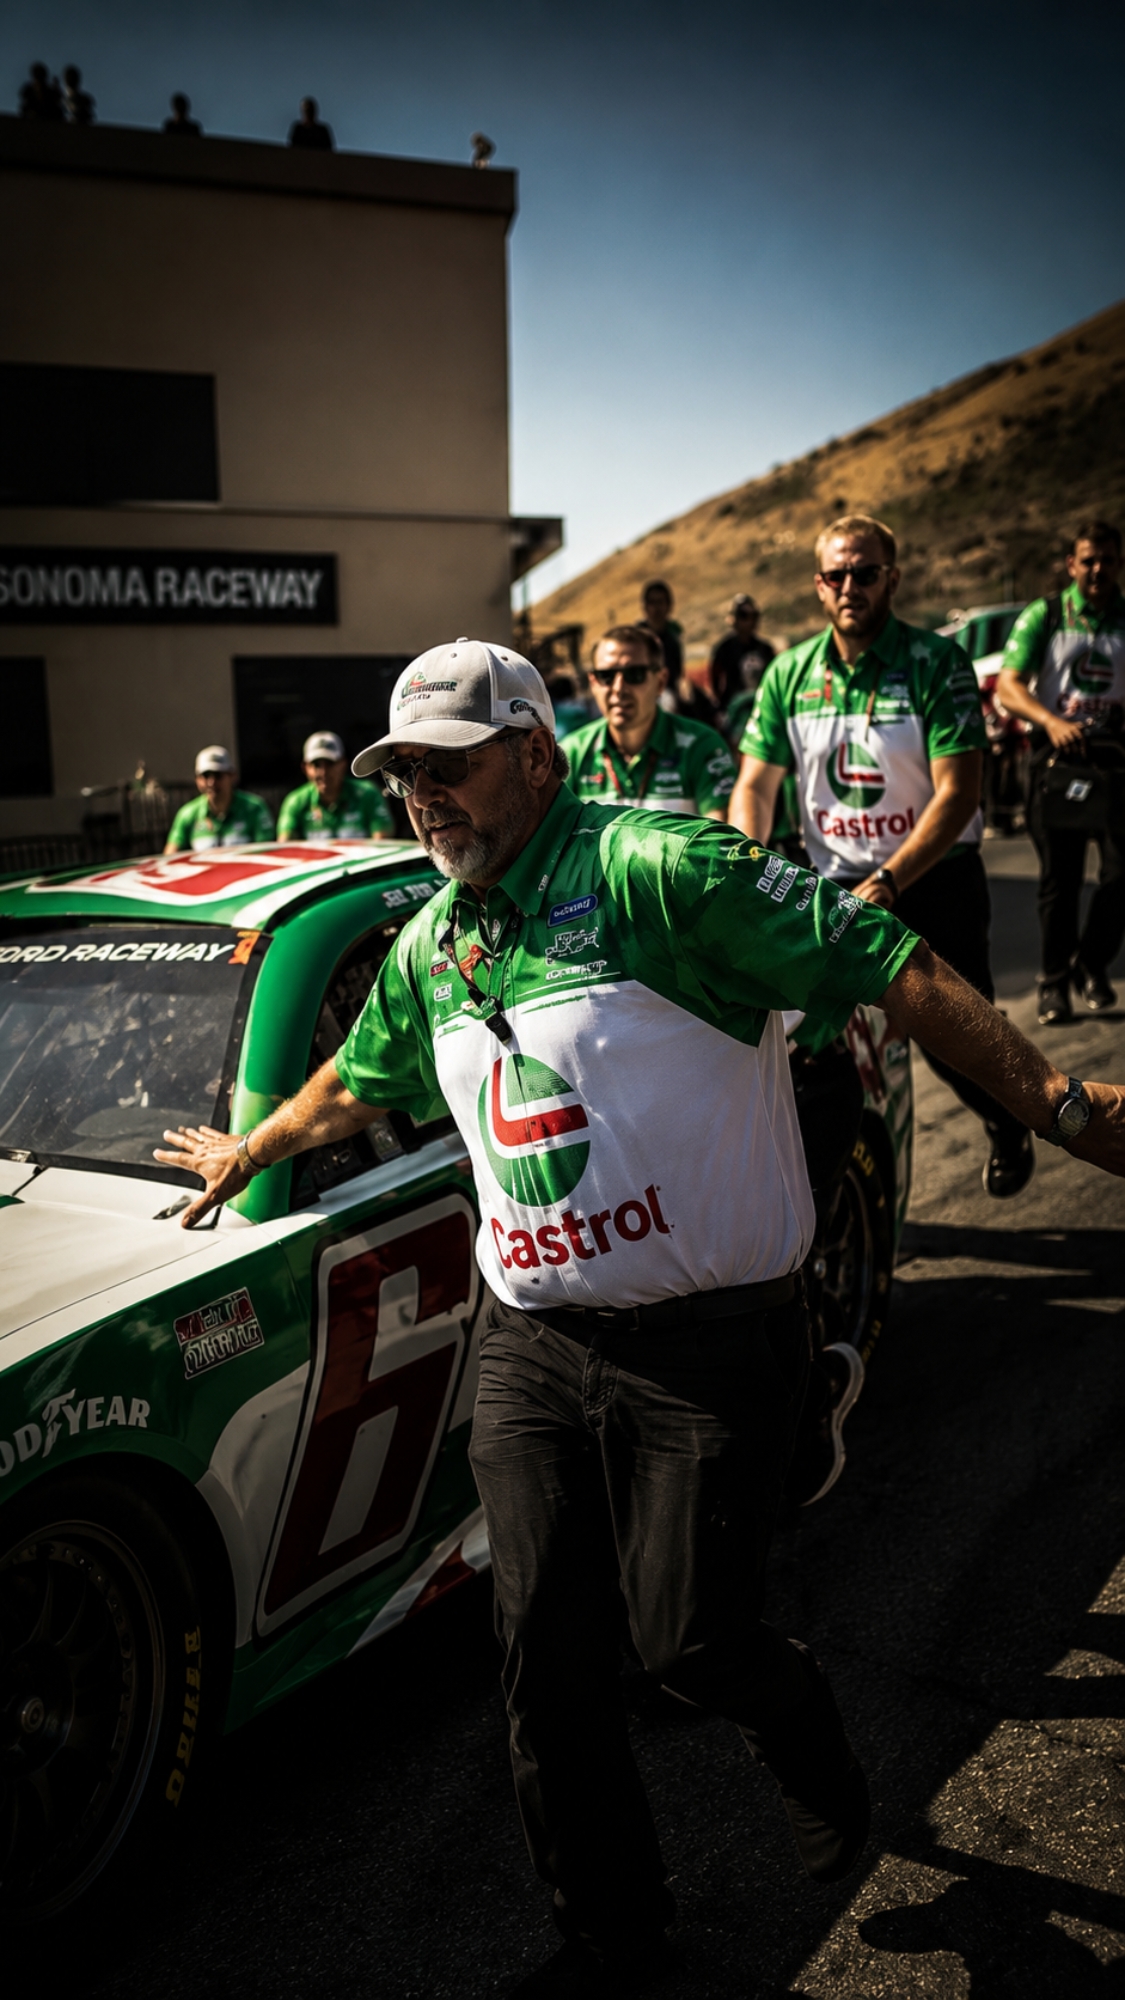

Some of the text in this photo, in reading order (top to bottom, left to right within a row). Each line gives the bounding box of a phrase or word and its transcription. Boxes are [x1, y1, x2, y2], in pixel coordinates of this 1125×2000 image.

[154, 566, 323, 609] RACEWAY
[818, 808, 915, 838] Castrol
[61, 942, 236, 962] RACEWAY
[491, 1184, 671, 1269] Castrol
[258, 1205, 473, 1625] 6
